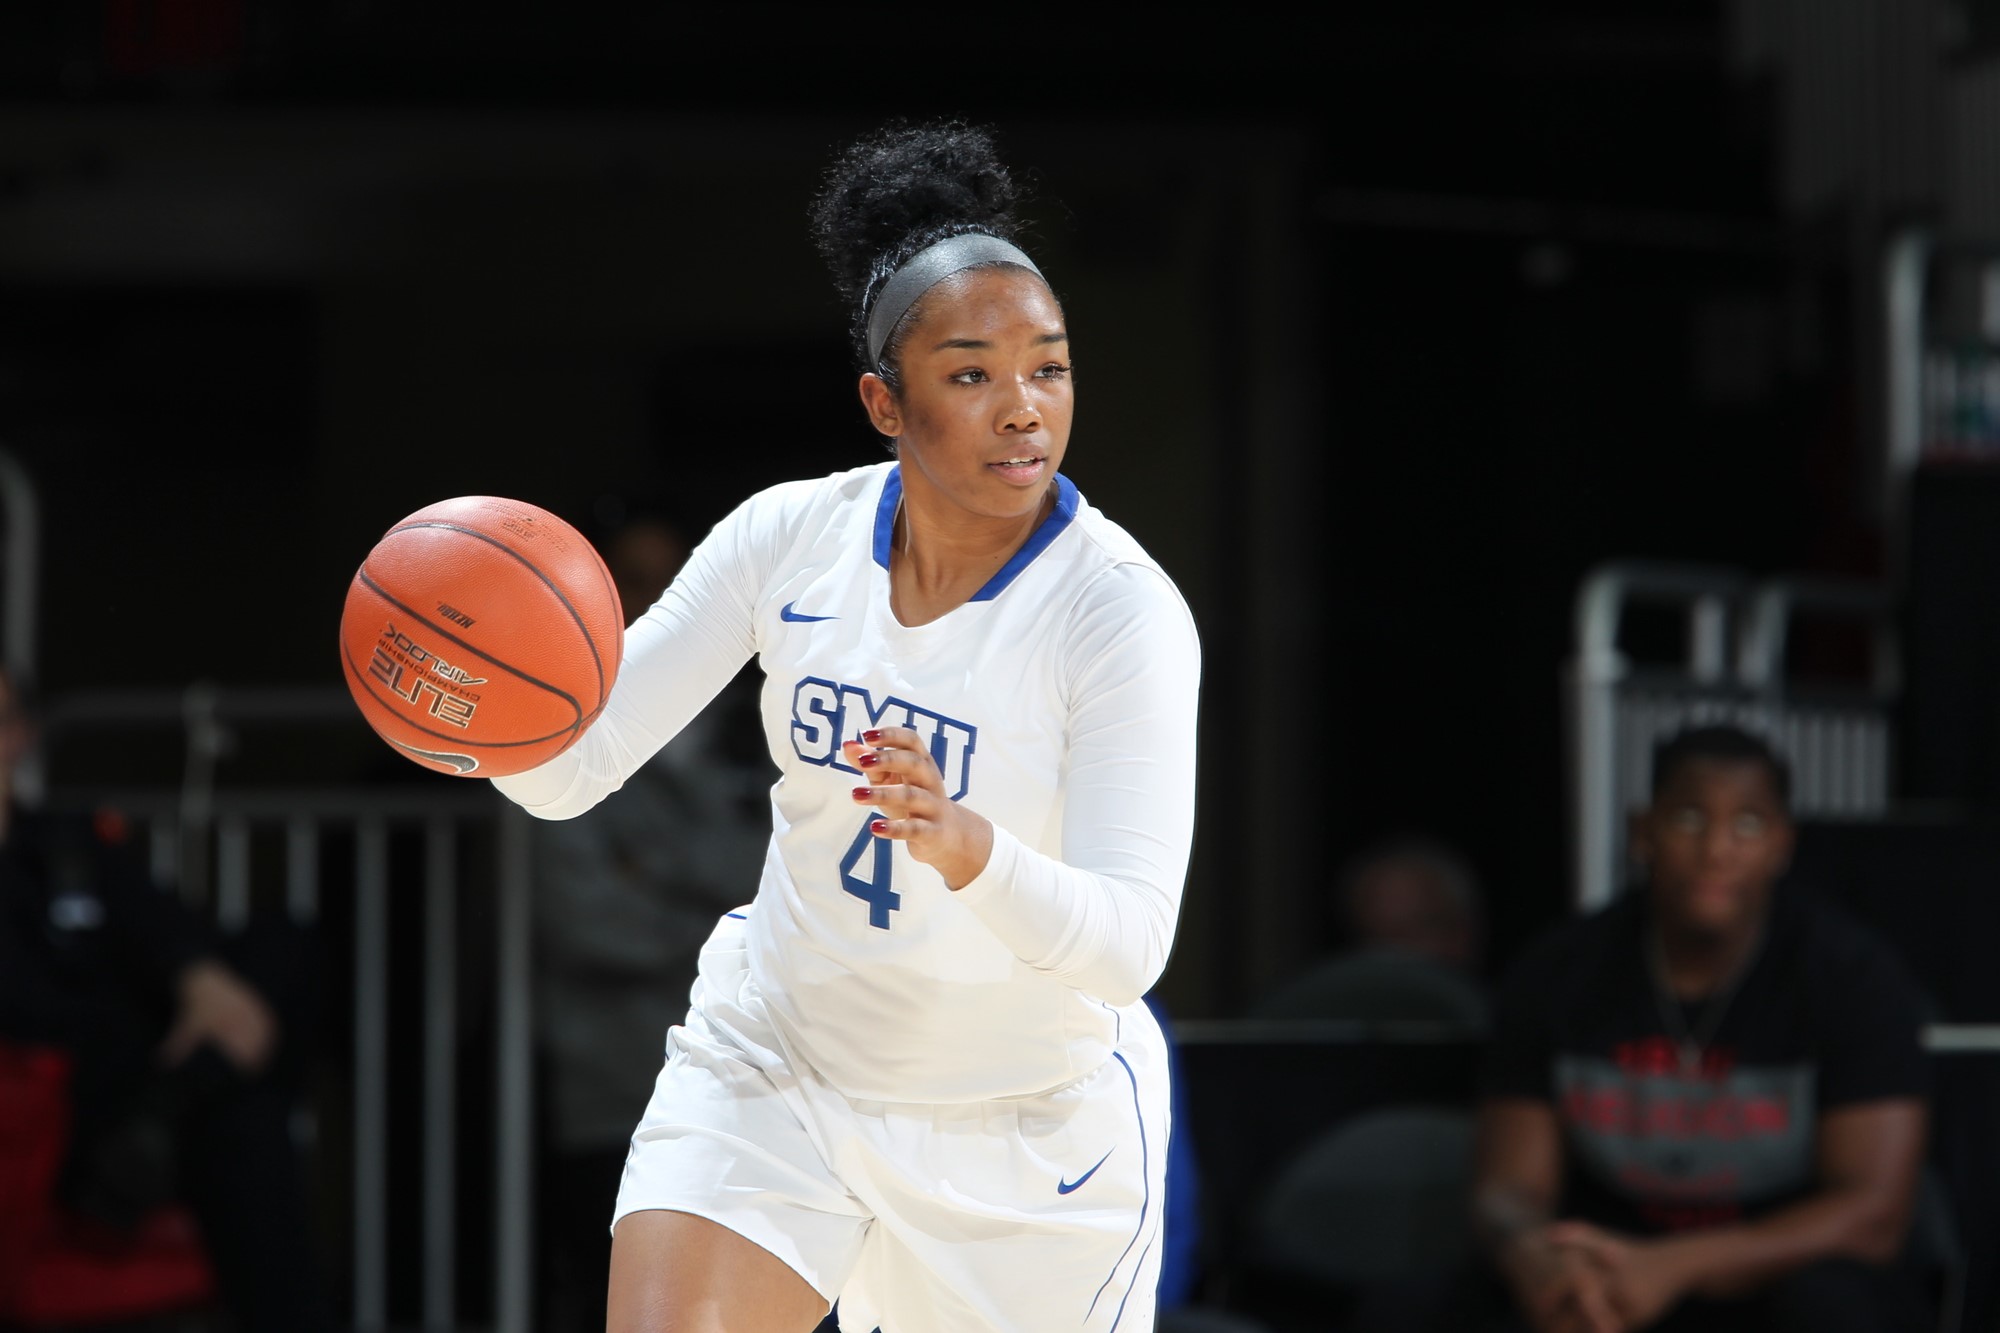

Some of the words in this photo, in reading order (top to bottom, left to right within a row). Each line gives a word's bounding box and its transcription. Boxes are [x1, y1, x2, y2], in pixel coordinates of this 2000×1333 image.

[368, 646, 477, 729] ELITE
[378, 639, 481, 701] CHAMPIONSHIP
[383, 620, 488, 686] AIRLOCK
[791, 675, 978, 802] SMU
[839, 811, 901, 930] 4
